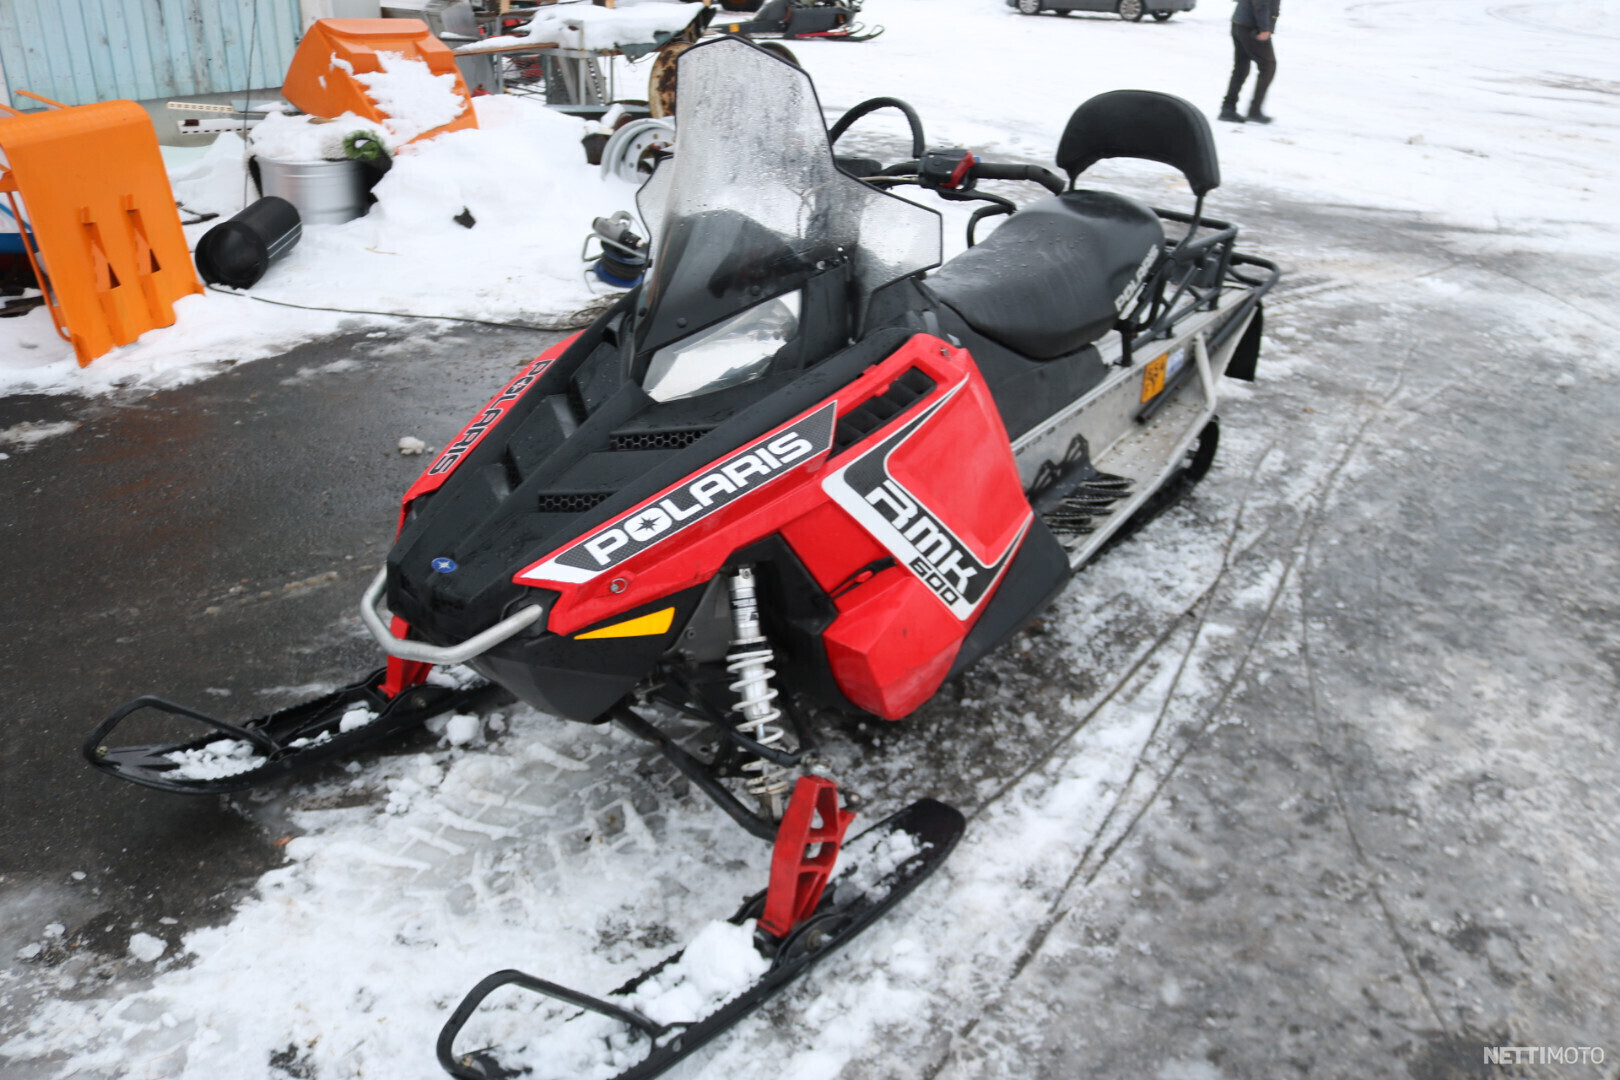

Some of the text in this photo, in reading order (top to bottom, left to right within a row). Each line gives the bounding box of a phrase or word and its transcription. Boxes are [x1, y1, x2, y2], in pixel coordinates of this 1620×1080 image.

[428, 359, 555, 476] POLARIS
[584, 431, 813, 567] POLARIS
[864, 479, 978, 595] RMK
[908, 556, 960, 606] 600
